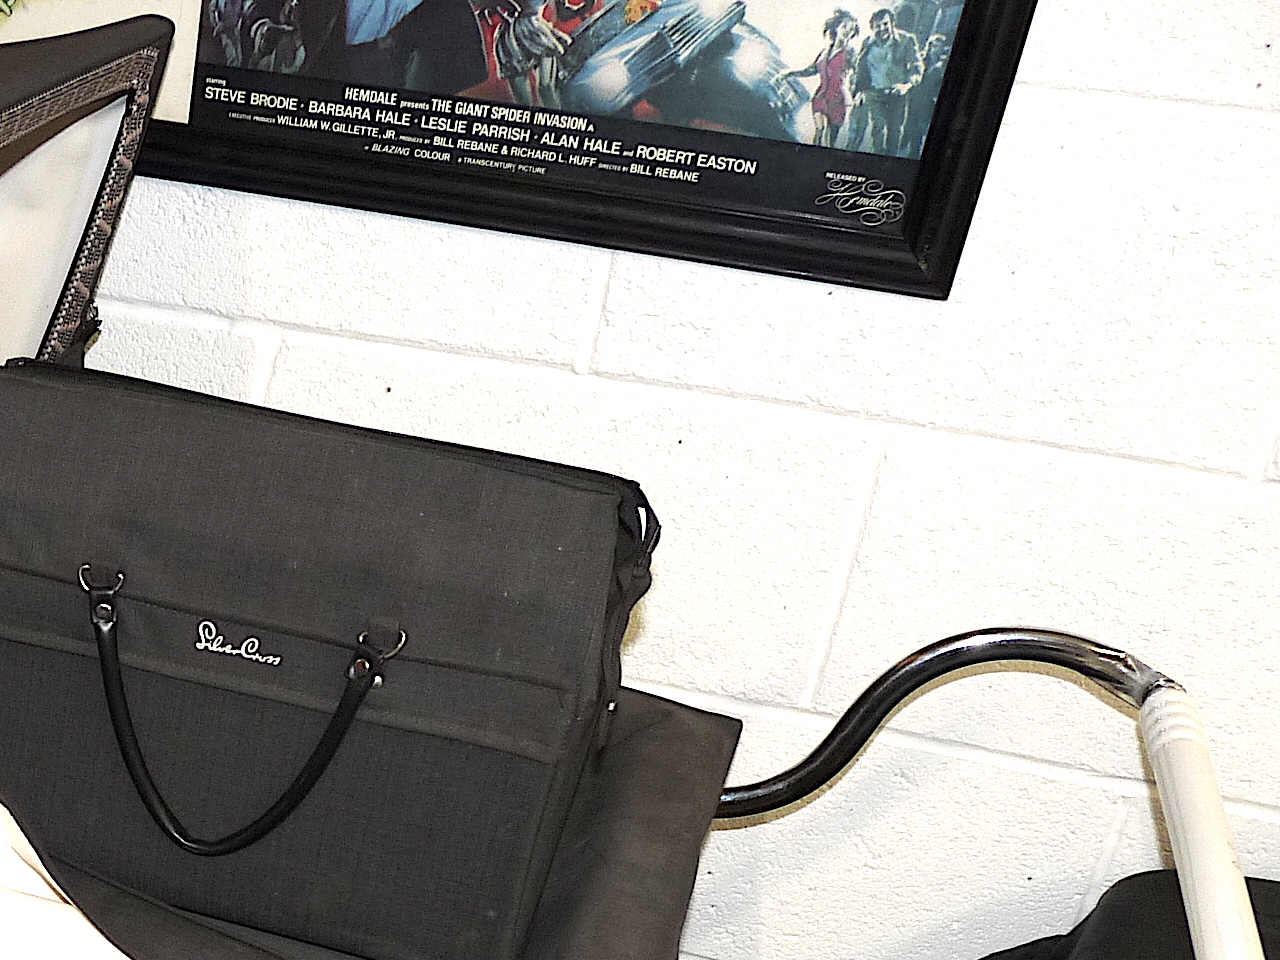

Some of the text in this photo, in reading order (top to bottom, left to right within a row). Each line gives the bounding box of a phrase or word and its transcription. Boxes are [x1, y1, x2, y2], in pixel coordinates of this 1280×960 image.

[345, 87, 397, 106] HEMDALE
[400, 100, 429, 111] presents
[431, 98, 452, 113] THE
[455, 101, 490, 118] GIANT
[490, 106, 531, 124] SPIDER
[533, 112, 588, 131] INVASION
[205, 86, 246, 104] STEVE
[250, 93, 299, 111] BRODIE
[308, 101, 371, 121] BARBARA
[375, 109, 412, 126] HALE
[421, 115, 467, 133] LESLIE
[472, 122, 531, 142] PARRISH
[540, 132, 580, 149] ALAN
[583, 137, 622, 155] HALE
[636, 145, 696, 165] ROBERT
[696, 154, 757, 175] EASTON
[277, 114, 318, 129] WILLIAM
[433, 136, 455, 148] BILL
[457, 139, 499, 154] REBANE
[501, 145, 508, 155] &
[510, 146, 557, 162] RICHARD
[569, 155, 597, 167] HUFF
[629, 163, 653, 176] BILL
[654, 167, 700, 182] REBANE
[371, 143, 410, 156] BLAZING
[414, 149, 451, 162] COLOUR
[518, 164, 546, 175] PICTURE
[825, 172, 857, 182] RELEASED
